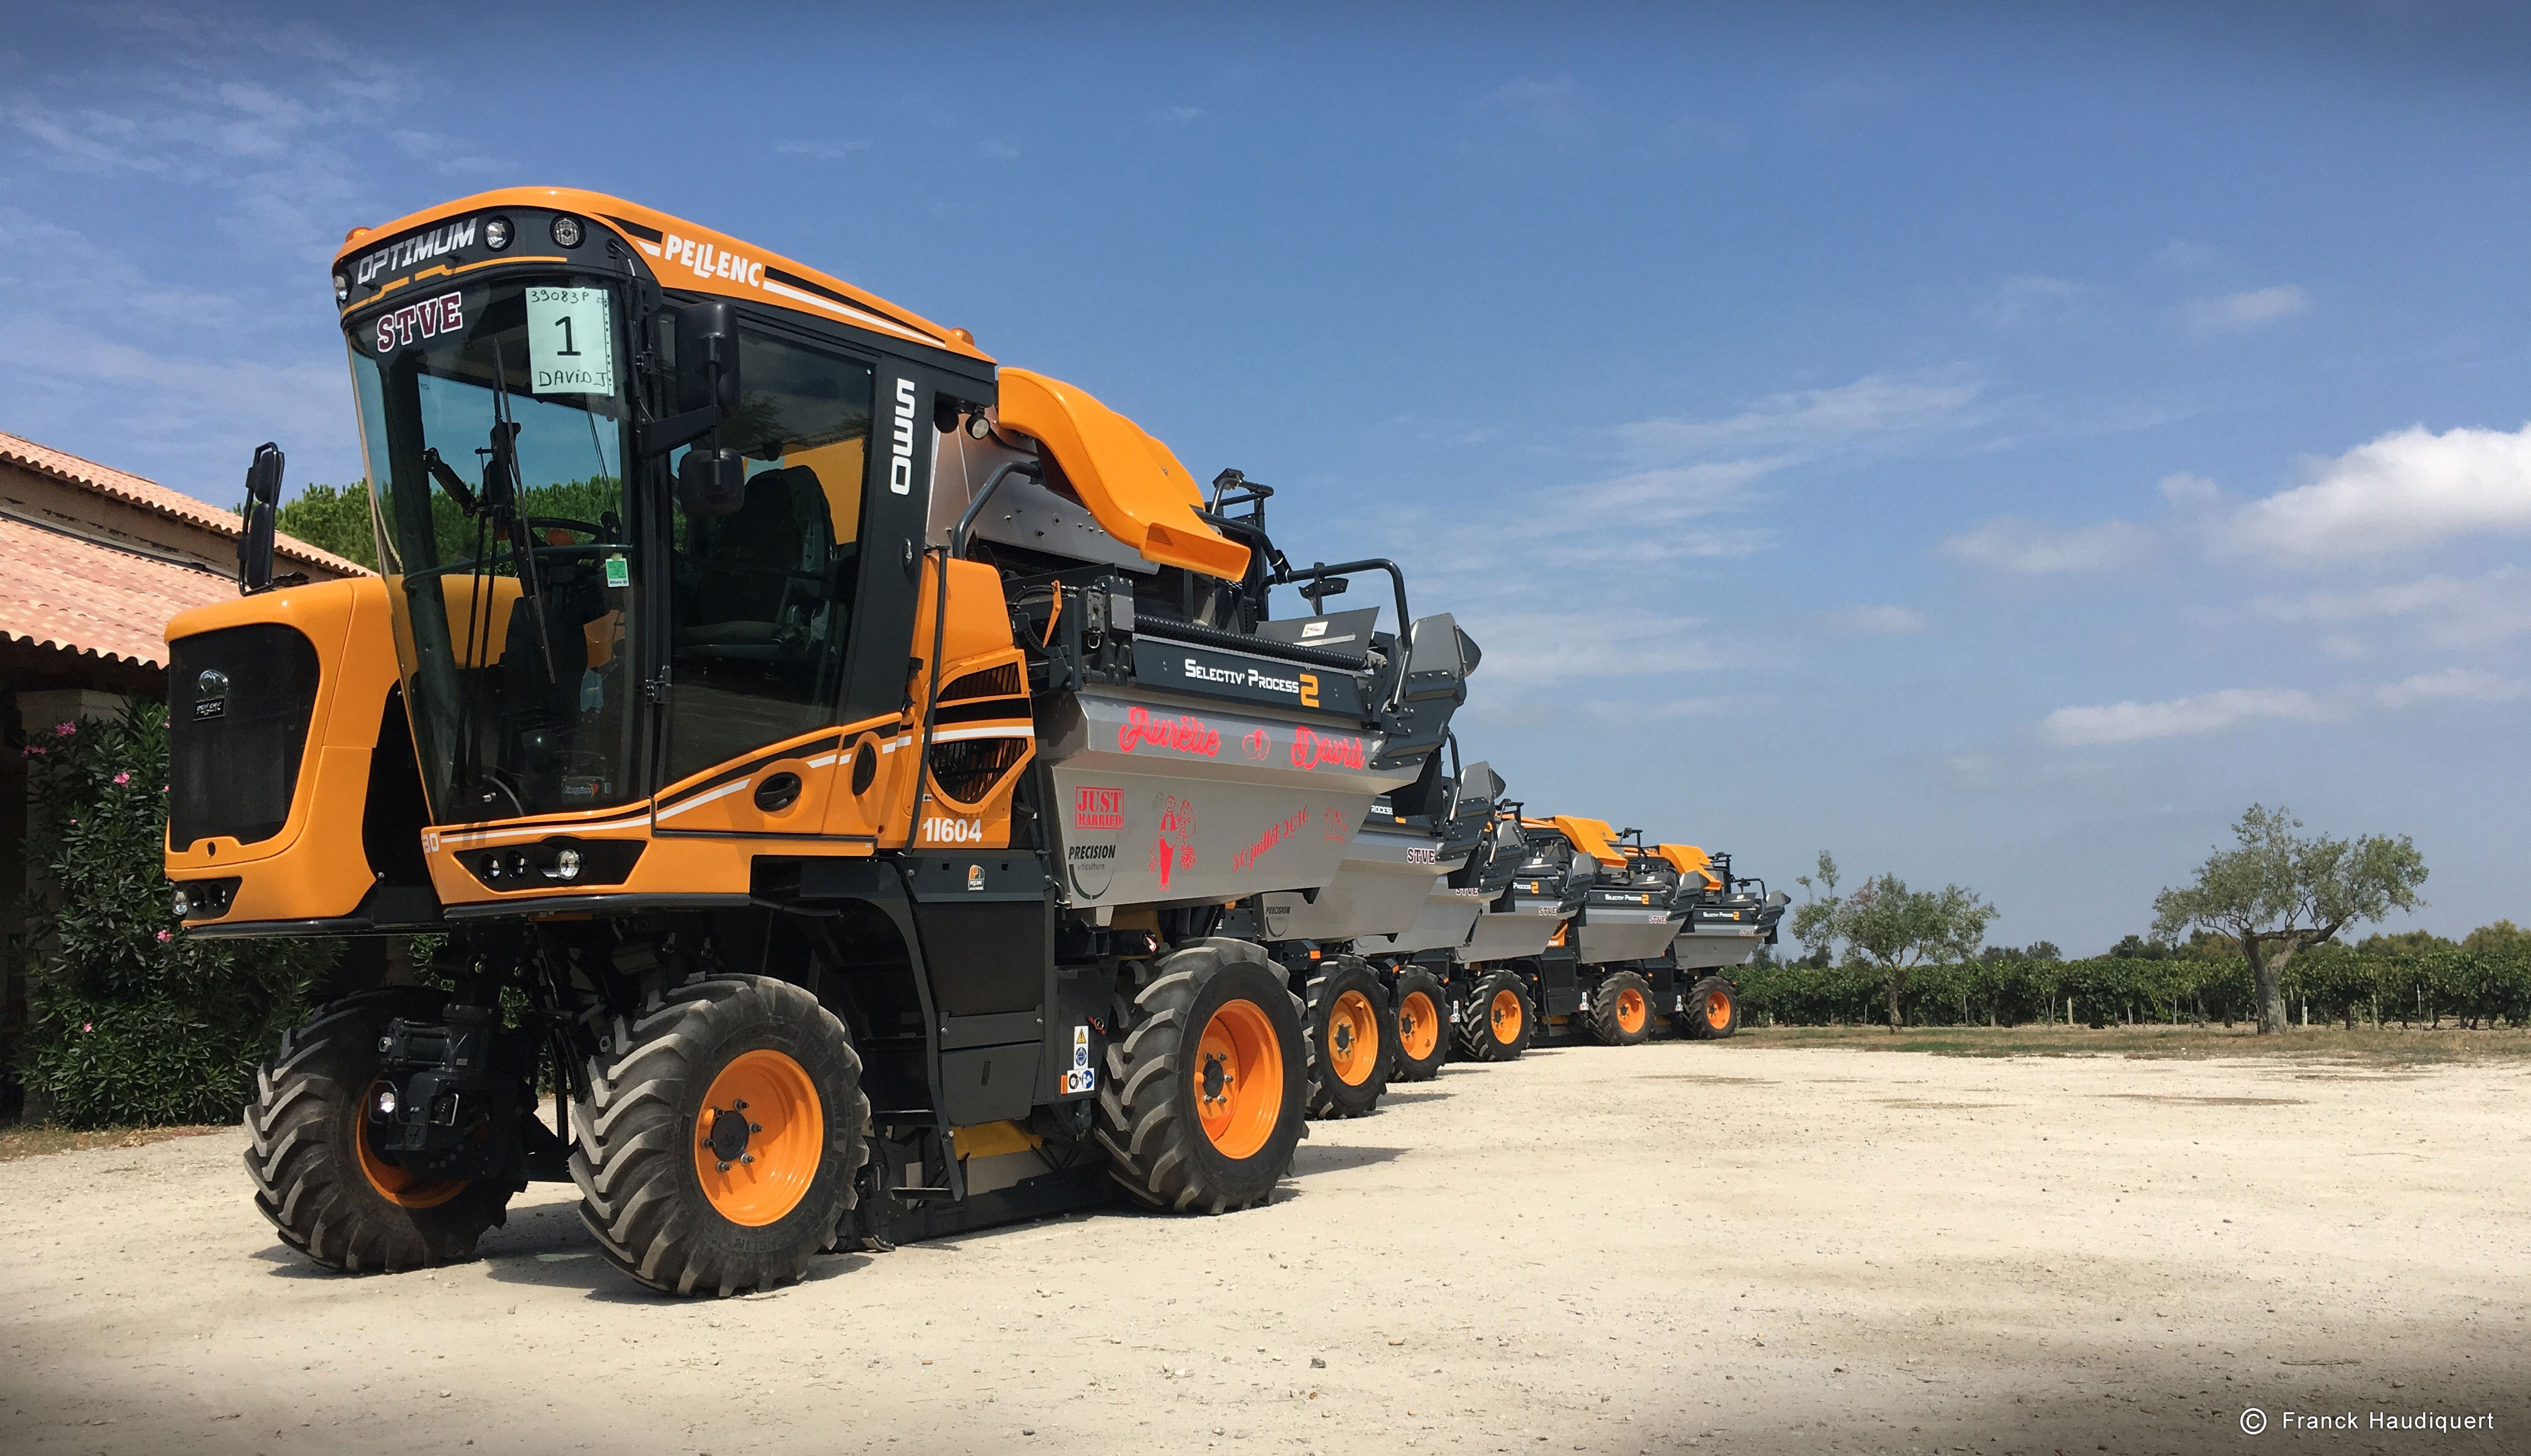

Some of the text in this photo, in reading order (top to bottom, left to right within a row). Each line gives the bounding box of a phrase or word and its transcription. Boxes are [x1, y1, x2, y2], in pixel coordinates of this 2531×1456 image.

[358, 218, 477, 284] OPTIMUM
[665, 234, 762, 287] PELLENC
[377, 291, 463, 352] STVE
[555, 316, 581, 356] 1
[1299, 673, 1319, 708] 2
[1118, 706, 1366, 770] Aurélie David
[1078, 791, 1121, 813] JUST
[1078, 814, 1121, 827] MARRIED
[1232, 803, 1309, 872] 30 juillet 2016
[1068, 845, 1116, 860] PRECISION
[1407, 847, 1435, 864] STVE
[1266, 906, 1291, 915] PRECISION
[1539, 906, 1557, 916] STVE
